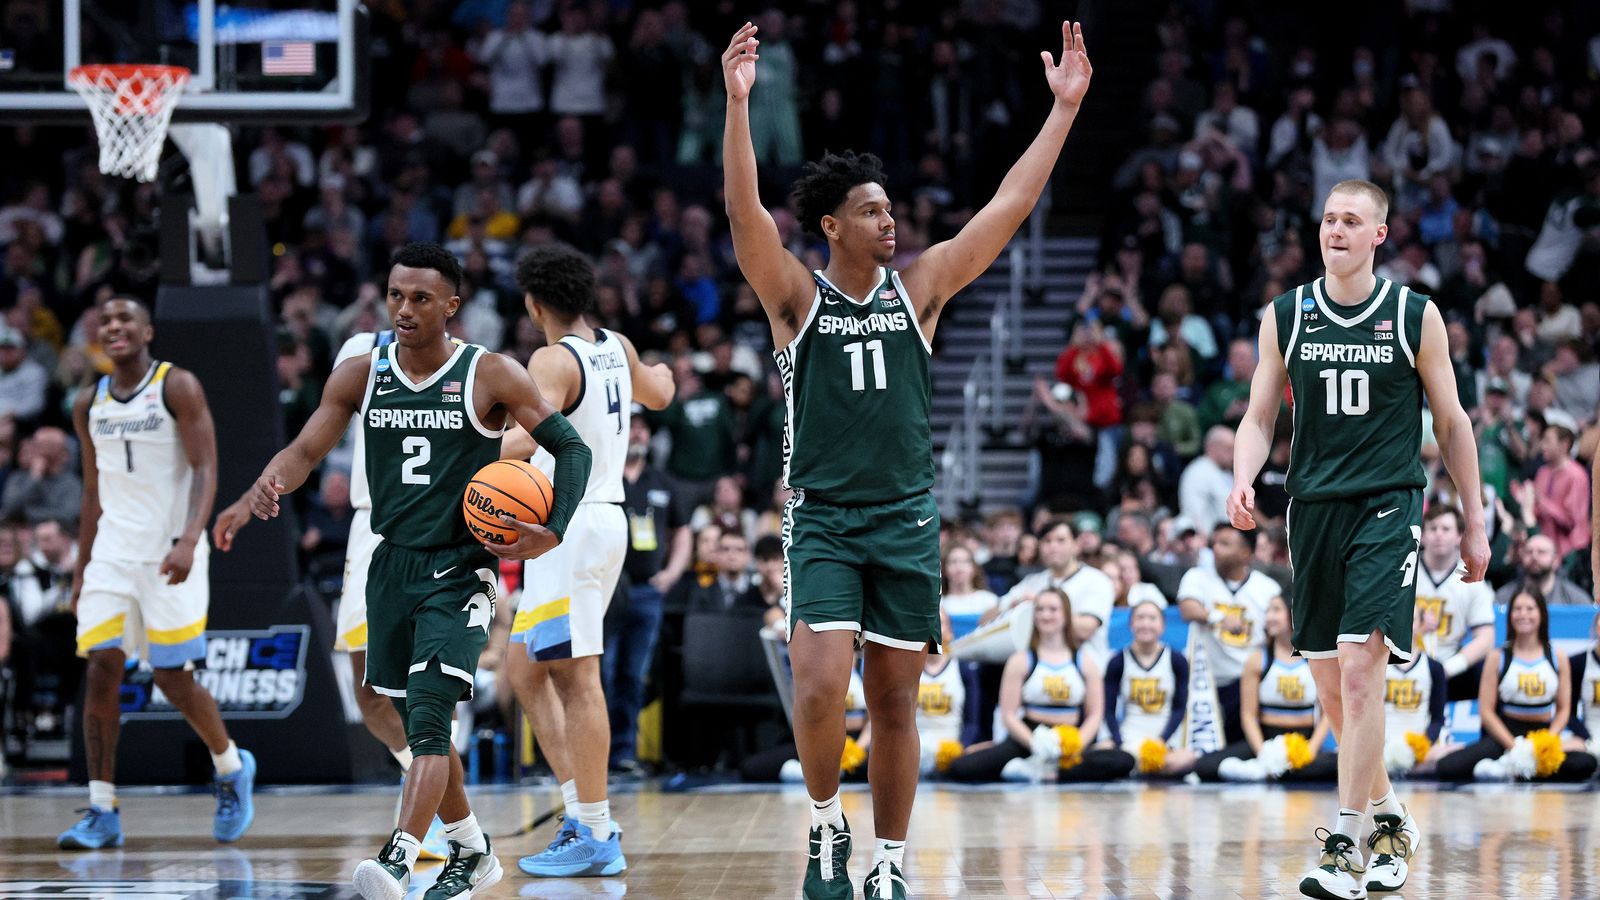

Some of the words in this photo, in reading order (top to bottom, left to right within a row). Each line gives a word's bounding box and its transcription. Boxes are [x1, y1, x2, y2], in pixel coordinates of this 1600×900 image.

[818, 312, 908, 336] SPARTANS
[588, 352, 625, 372] MITCHELL
[843, 339, 887, 391] 11
[1300, 343, 1394, 363] SPARTANS
[604, 378, 624, 435] 4
[1319, 368, 1370, 415] 10
[94, 412, 164, 439] Marquette
[369, 409, 464, 429] SPARTANS
[125, 440, 135, 473] 1
[402, 436, 431, 485] 2
[468, 520, 505, 543] NCAA
[151, 669, 299, 704] DNESS
[1128, 678, 1166, 713] MU
[1518, 672, 1546, 697] MU
[1190, 702, 1216, 752] ING
